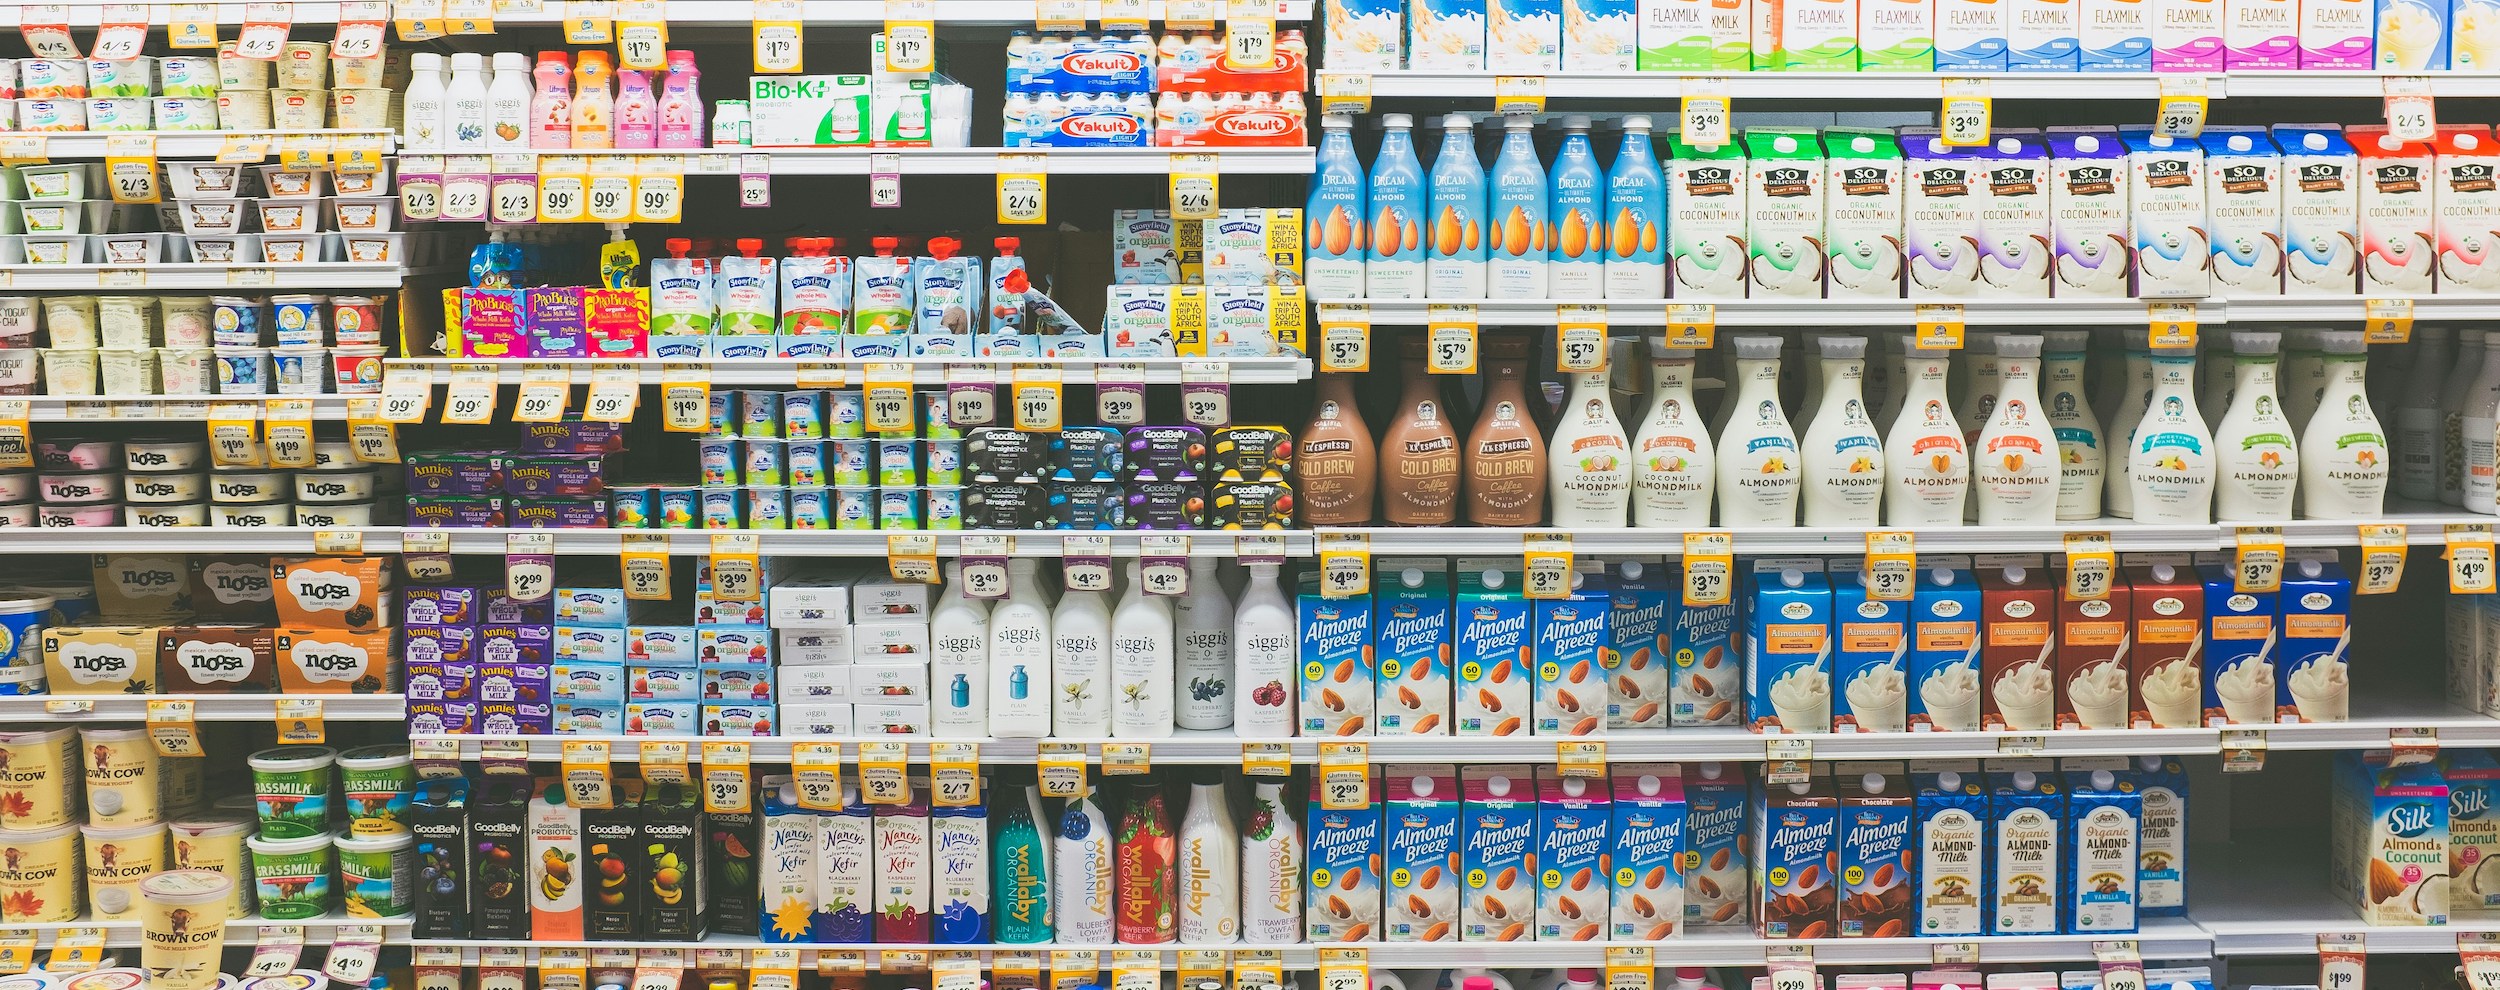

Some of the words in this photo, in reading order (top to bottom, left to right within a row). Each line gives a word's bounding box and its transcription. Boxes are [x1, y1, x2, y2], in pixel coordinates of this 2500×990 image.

[1653, 8, 1700, 22] FLAXMILK
[1876, 10, 1921, 24] FLAXMILK
[2023, 10, 2068, 24] FLAXMILK
[2166, 10, 2212, 24] FLAXMILK
[2316, 9, 2362, 23] FLAXMILK
[1076, 58, 1128, 73] Yakult
[1073, 120, 1127, 134] Yakult
[1227, 119, 1279, 133] Yakult
[2157, 161, 2180, 172] SO
[2387, 165, 2409, 177] SO
[1435, 175, 1467, 186] DREAM
[1559, 178, 1591, 188] DREAM
[1929, 202, 1962, 210] ORGANIC
[2141, 201, 2200, 212] COCONUTMILK
[2369, 207, 2428, 217] COCONUTMILK
[1914, 210, 1975, 221] COCONUTMILK
[1131, 222, 1169, 234] Stonyfield
[661, 278, 700, 290] Stonyfield
[792, 277, 830, 288] Stonyfield
[3, 318, 18, 327] CHIA
[531, 426, 570, 438] Annie's
[1144, 430, 1188, 439] GoodBelly
[130, 452, 167, 466] noosa
[414, 466, 453, 477] Annie's
[1299, 462, 1320, 475] COLD
[1324, 460, 1354, 474] BREW
[1476, 461, 1501, 475] COLD
[1506, 459, 1533, 474] BREW
[1576, 474, 1622, 482] COCONUT
[1981, 476, 2050, 485] ALMONDMILK
[2137, 475, 2206, 484] ALMONDMILK
[135, 481, 176, 496] noosa
[306, 481, 346, 496] noosa
[1311, 481, 1341, 492] Coffee
[1564, 482, 1629, 491] ALMONDMILK
[301, 583, 350, 599] noosa
[1305, 611, 1367, 644] Almond
[1462, 611, 1526, 643] Almond
[2291, 619, 2342, 628] Almondmilk
[1771, 628, 1823, 639] Almondmilk
[2144, 625, 2194, 635] Almondmilk
[410, 645, 439, 654] WHOLE
[939, 635, 981, 653] siggi's
[1056, 634, 1098, 653] siggi's
[1476, 631, 1518, 656] Breeze
[415, 653, 433, 661] MILK
[73, 656, 126, 671] noosa
[481, 666, 514, 678] Annie's
[1309, 666, 1320, 674] 60
[2387, 807, 2434, 836] Silk
[414, 824, 461, 834] GoodBelly
[531, 828, 578, 836] PROBIOTICS
[588, 825, 636, 836] GoodBelly
[1931, 829, 1974, 841] Organic
[2086, 827, 2129, 839] Organic
[823, 831, 866, 851] Nancy's
[939, 830, 982, 851] Nancy's
[1406, 838, 1449, 863] Breeze
[2093, 849, 2123, 860] Milk
[1938, 852, 1968, 862] Milk
[2386, 852, 2441, 863] Coconut
[256, 863, 322, 876] GRASSMILK
[829, 858, 859, 873] Kefir
[945, 858, 973, 874] Kefir
[2407, 867, 2418, 876] 35
[1090, 836, 1112, 916] wallaby
[1280, 836, 1298, 916] wallaby
[1396, 872, 1407, 880] 30
[1847, 870, 1862, 878] 100
[1017, 844, 1038, 924] wallaby
[1257, 917, 1300, 926] STRAWBERRY
[146, 931, 190, 943] BROWN
[192, 930, 219, 942] COW
